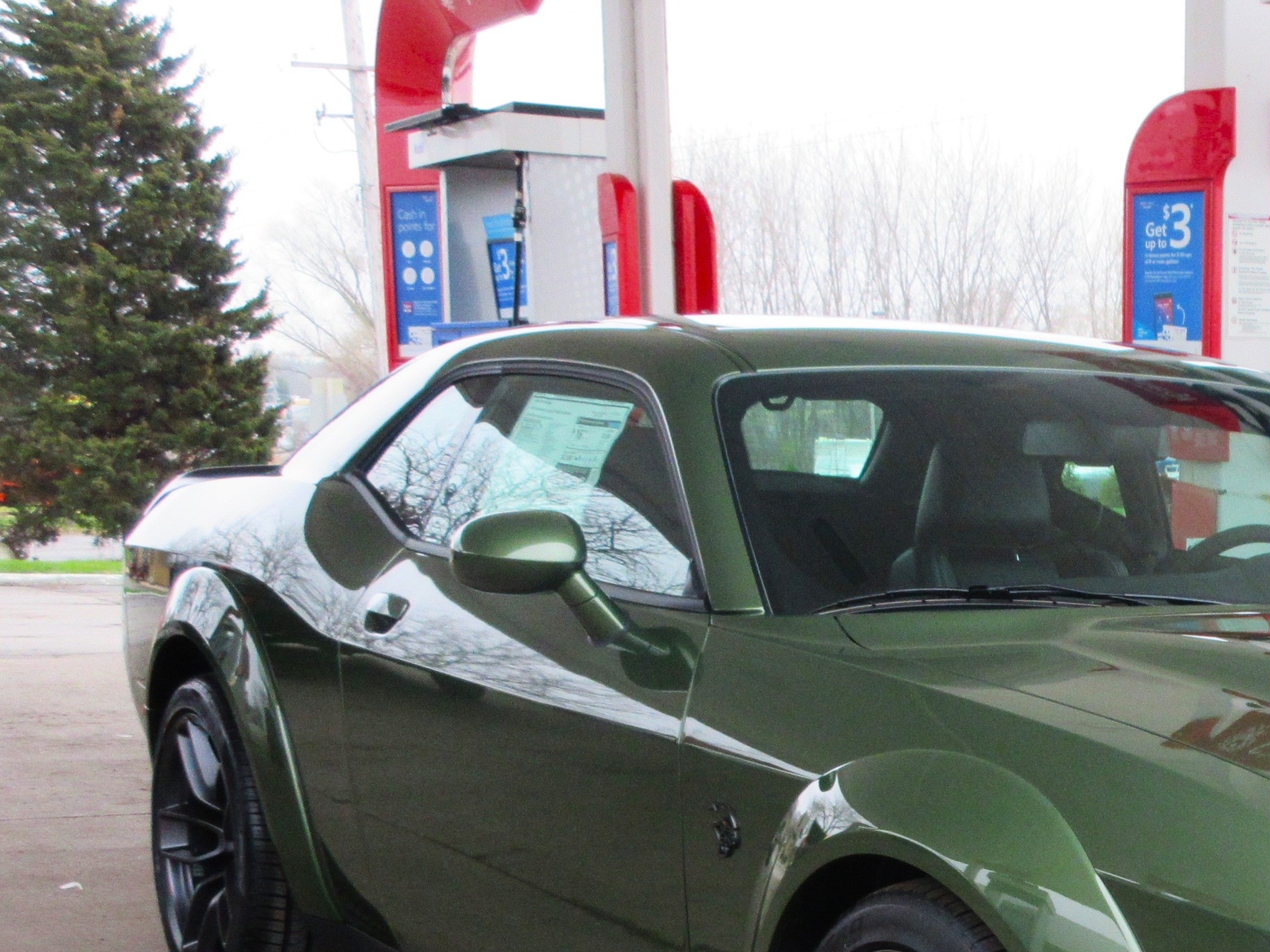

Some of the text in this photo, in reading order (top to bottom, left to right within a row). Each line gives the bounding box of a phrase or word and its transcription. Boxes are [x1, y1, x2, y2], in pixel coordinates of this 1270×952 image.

[1145, 222, 1167, 237] Get
[1145, 239, 1167, 252] up to
